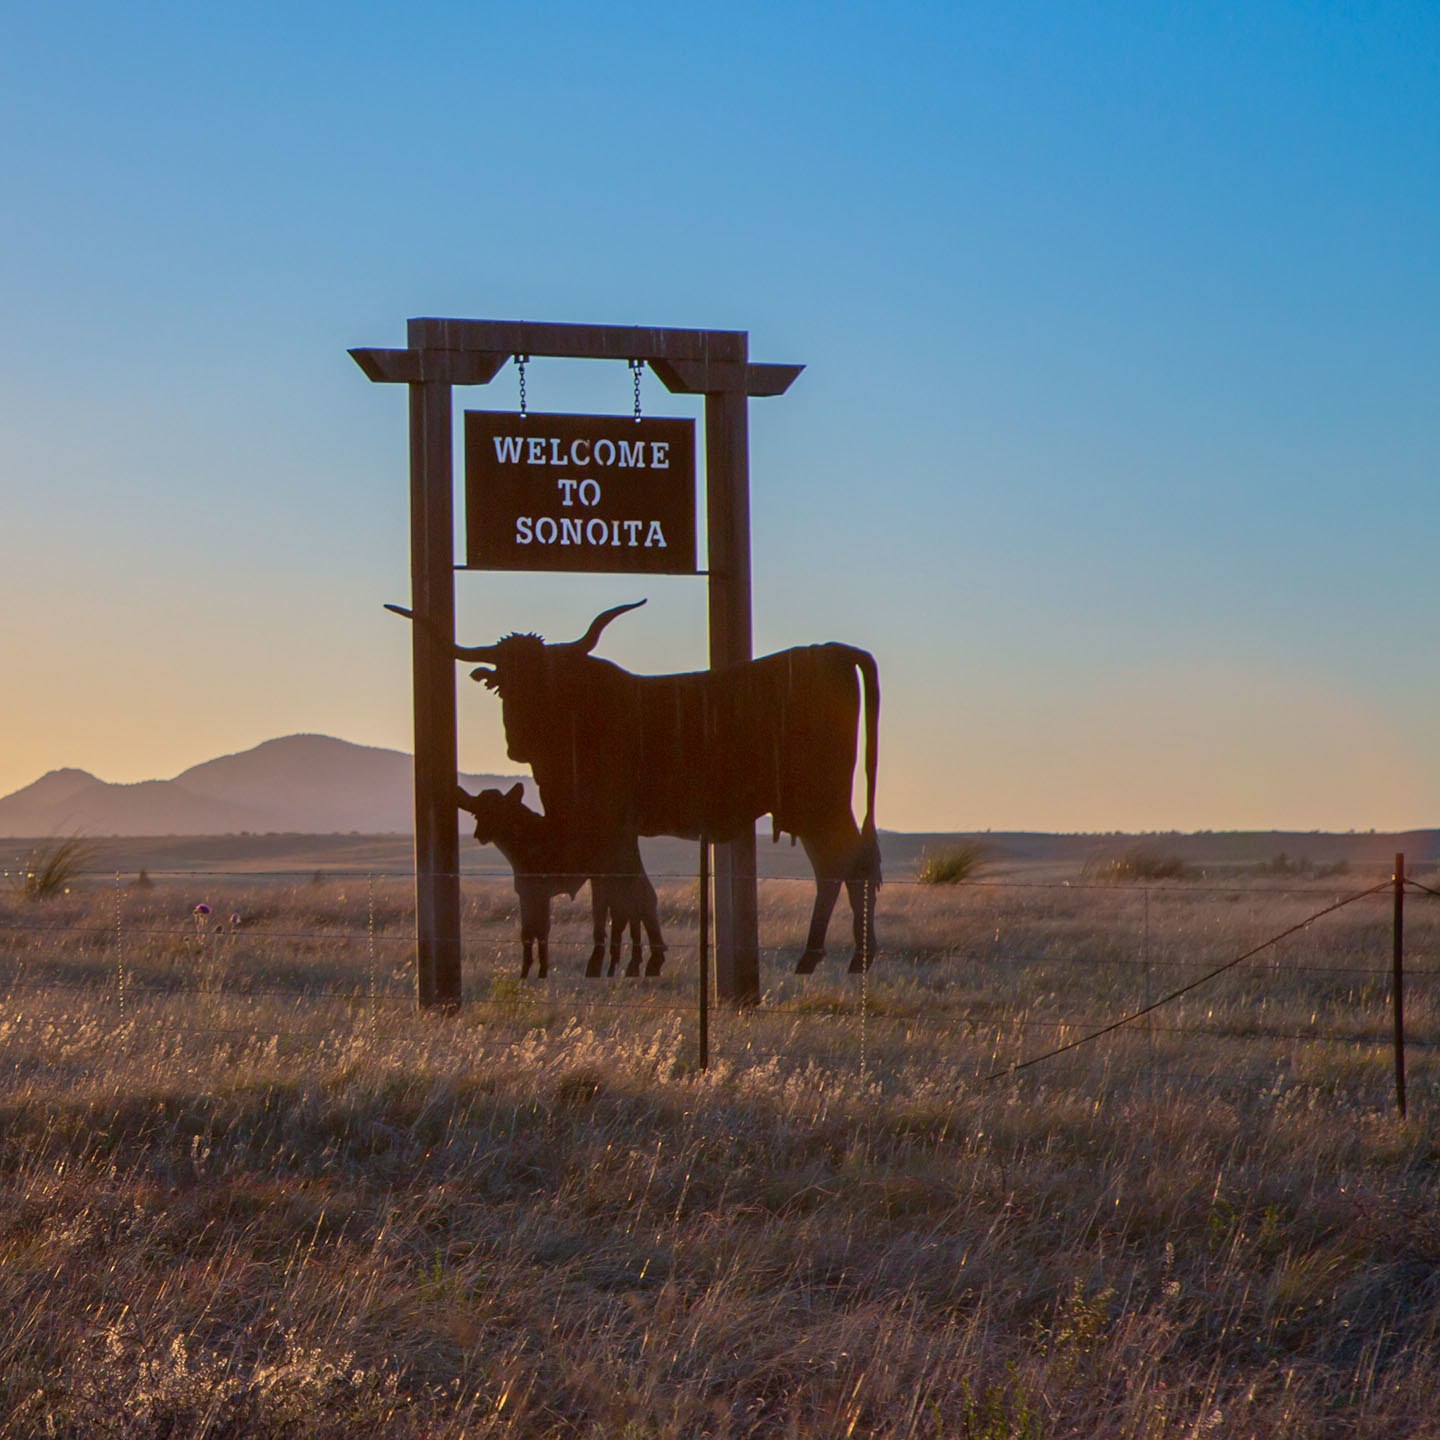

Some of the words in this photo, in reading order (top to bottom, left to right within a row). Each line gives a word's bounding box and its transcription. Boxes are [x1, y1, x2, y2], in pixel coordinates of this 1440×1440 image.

[493, 436, 669, 469] WELCOME
[558, 479, 601, 506] TO
[515, 516, 667, 548] SONOITA
